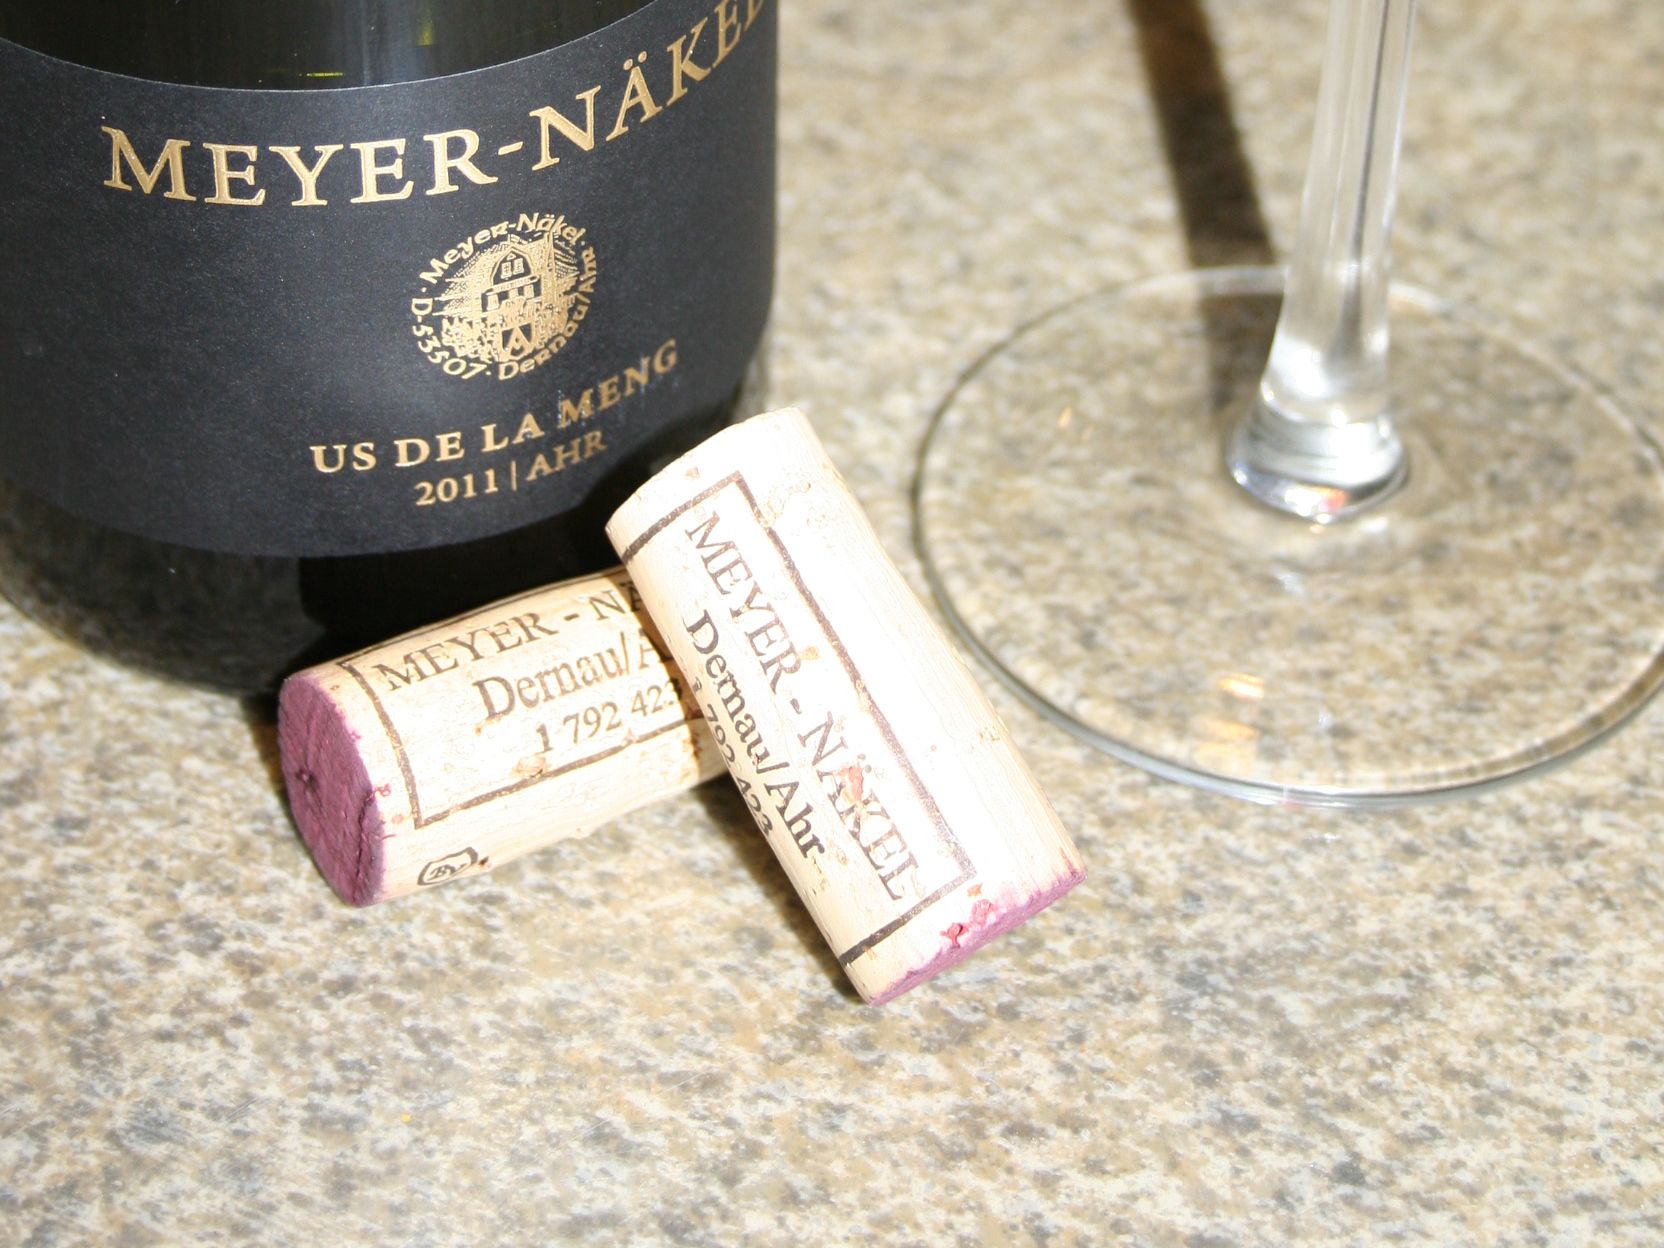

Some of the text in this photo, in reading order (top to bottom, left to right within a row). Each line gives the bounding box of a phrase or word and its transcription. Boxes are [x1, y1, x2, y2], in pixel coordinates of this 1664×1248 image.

[310, 338, 679, 474] US DE LA MENG
[414, 468, 499, 507] 2011
[525, 429, 608, 481] AHR
[372, 612, 559, 692] MEYER
[685, 511, 801, 694] MEYER
[536, 723, 553, 754] 1
[563, 701, 623, 745] 792
[681, 608, 826, 859] Dernau/Ahr
